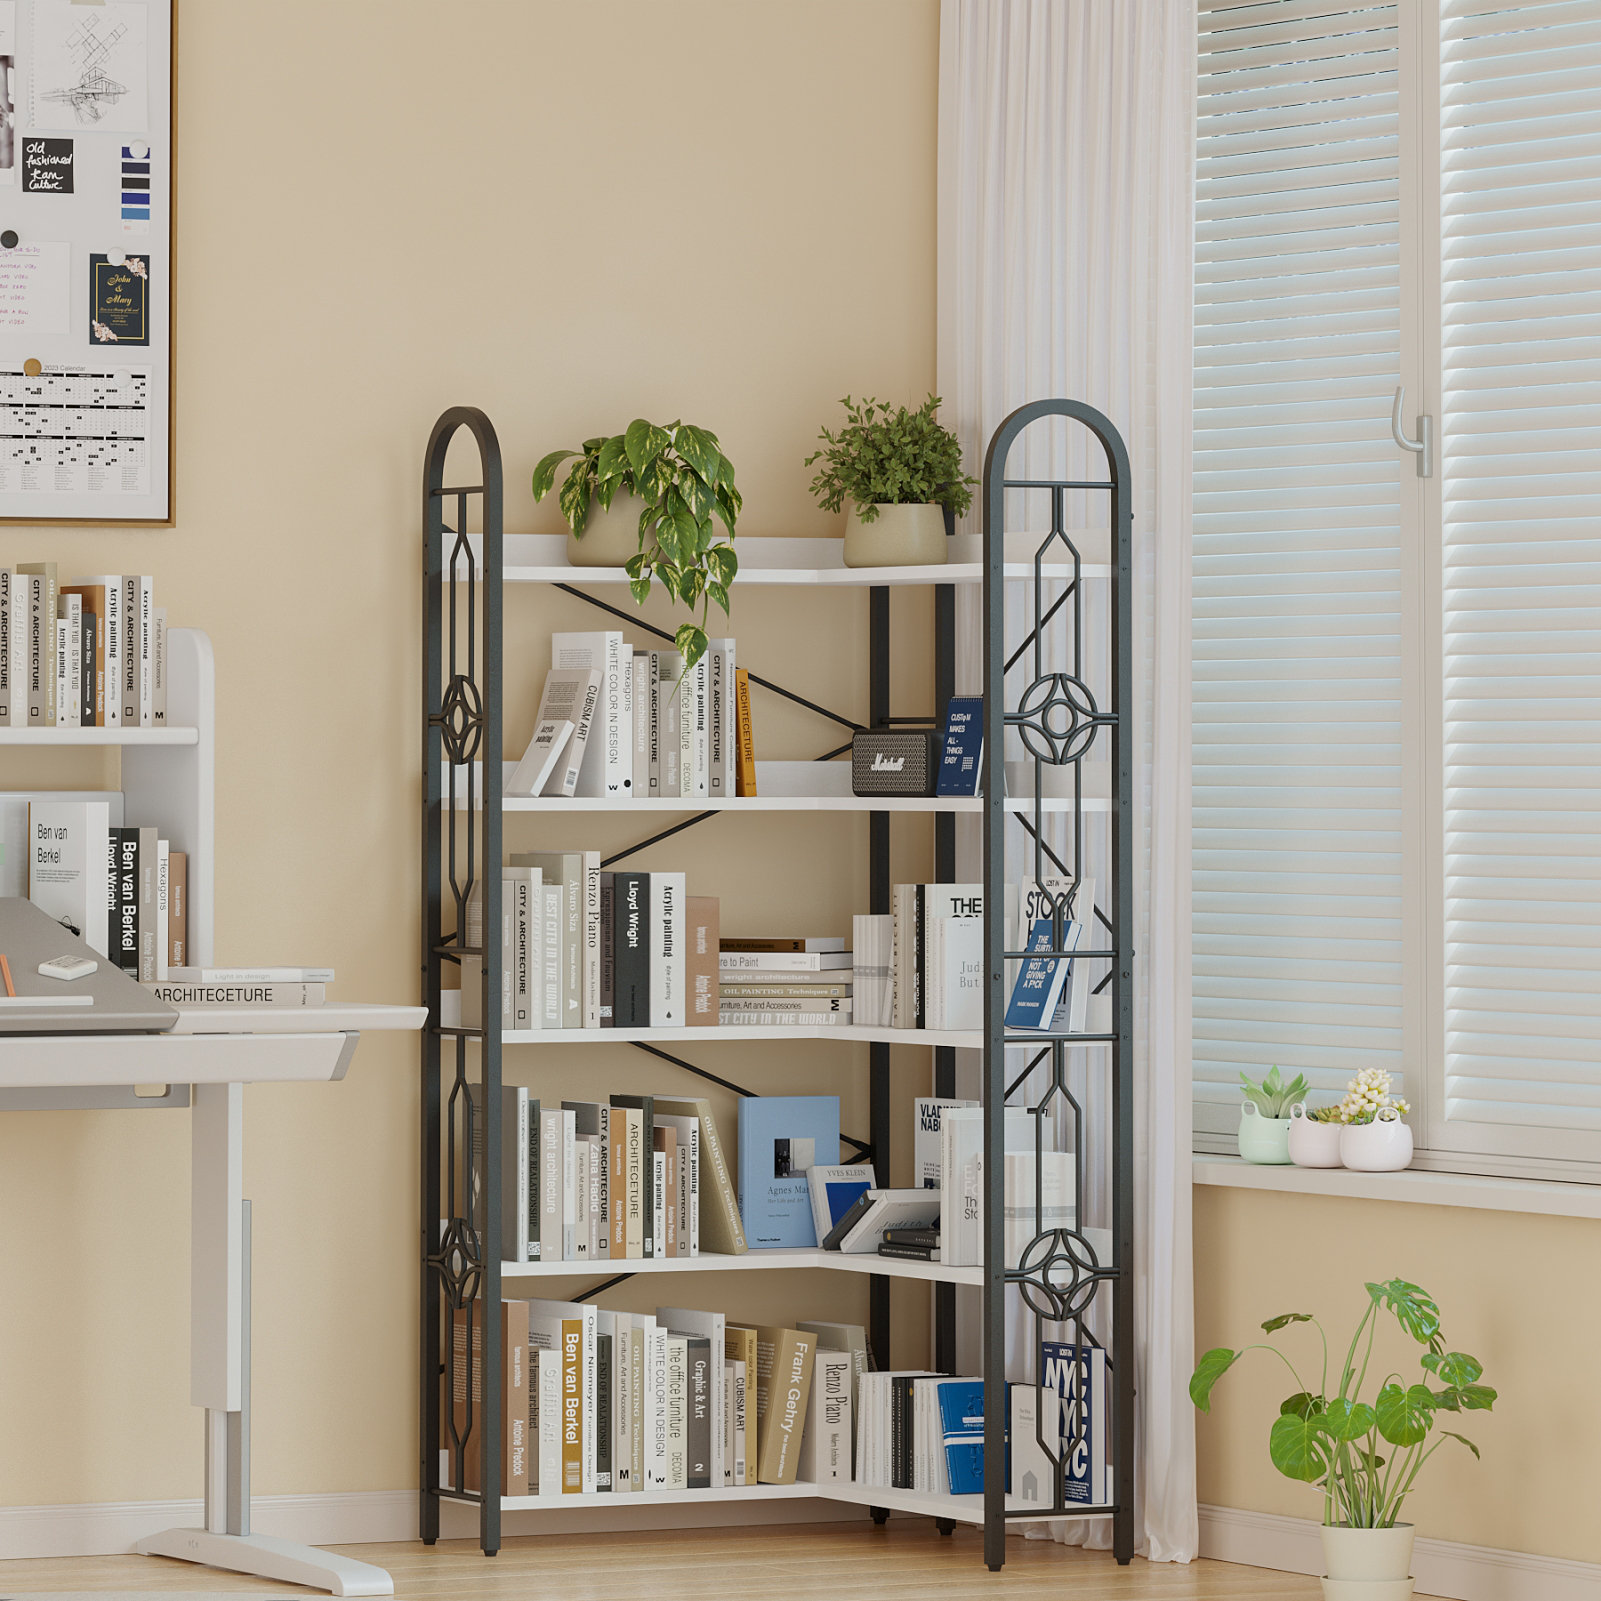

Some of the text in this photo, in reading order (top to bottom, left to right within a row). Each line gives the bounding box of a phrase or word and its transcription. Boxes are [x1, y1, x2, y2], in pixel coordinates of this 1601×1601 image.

[26, 141, 45, 154] Old
[26, 153, 72, 168] fashioned
[107, 274, 131, 286] John
[106, 294, 132, 306] Mary
[109, 588, 117, 659] Acrylic painting
[623, 661, 632, 712] Hexagons
[697, 662, 705, 731] Acrylic painting
[714, 679, 720, 687] &
[576, 685, 598, 742] CUBISM ART
[609, 639, 618, 764] WHITE COLOR IN DESIGN
[637, 662, 646, 752] wright architecture
[739, 681, 752, 763] ARCHITECETURE
[949, 725, 965, 733] MAKES
[946, 747, 963, 755] THINGS
[37, 824, 67, 840] Ben van
[37, 848, 61, 863] Berkel
[122, 842, 136, 951] Ben van Berkel
[158, 858, 167, 911] Hexagons
[588, 867, 600, 948] Renzo Piano
[626, 881, 639, 948] Lloyd Wright
[950, 898, 982, 913] THE
[570, 913, 579, 932] Siza
[662, 886, 673, 957] Acrylic painting
[1038, 935, 1049, 944] THE
[244, 973, 270, 981] design
[960, 961, 984, 974] Jud
[1026, 971, 1046, 980] GIVING
[1029, 962, 1042, 971] NOT
[154, 988, 273, 1002] ARCHITECETURE
[720, 1002, 741, 1010] urniture,
[831, 1000, 839, 1011] M
[530, 1127, 538, 1145] END
[601, 1134, 607, 1142] &
[530, 1147, 538, 1158] OF
[544, 1118, 558, 1213] wright architecture
[590, 1143, 599, 1174] Zaha
[704, 1116, 740, 1235] OIL PAINTING Techniques
[768, 1185, 809, 1196] Agnes Mar
[590, 1177, 599, 1212] Hadid
[964, 1196, 977, 1207] Th
[670, 1347, 684, 1362] the
[529, 1351, 539, 1429] the famous architect
[566, 1333, 579, 1444] Ben van Berkel
[586, 1356, 594, 1413] Niemeyer
[600, 1381, 607, 1392] OF
[620, 1332, 628, 1435] Furniture, Art and Accessories
[692, 1360, 707, 1418] Graphic & Art
[780, 1342, 808, 1433] Frank Gehry
[1045, 1357, 1088, 1399] NYC
[656, 1335, 665, 1457] WHITE COLOR IN DESIGN
[736, 1377, 745, 1432] CUBISM ART
[826, 1364, 848, 1424] Renzo Piano
[670, 1397, 684, 1438] furniture
[1059, 1399, 1088, 1438] YC
[513, 1420, 524, 1476] Antoine Predock
[1060, 1437, 1088, 1478] YC
[620, 1470, 629, 1480] M
[672, 1452, 682, 1483] DECOMA
[695, 1463, 703, 1471] 2
